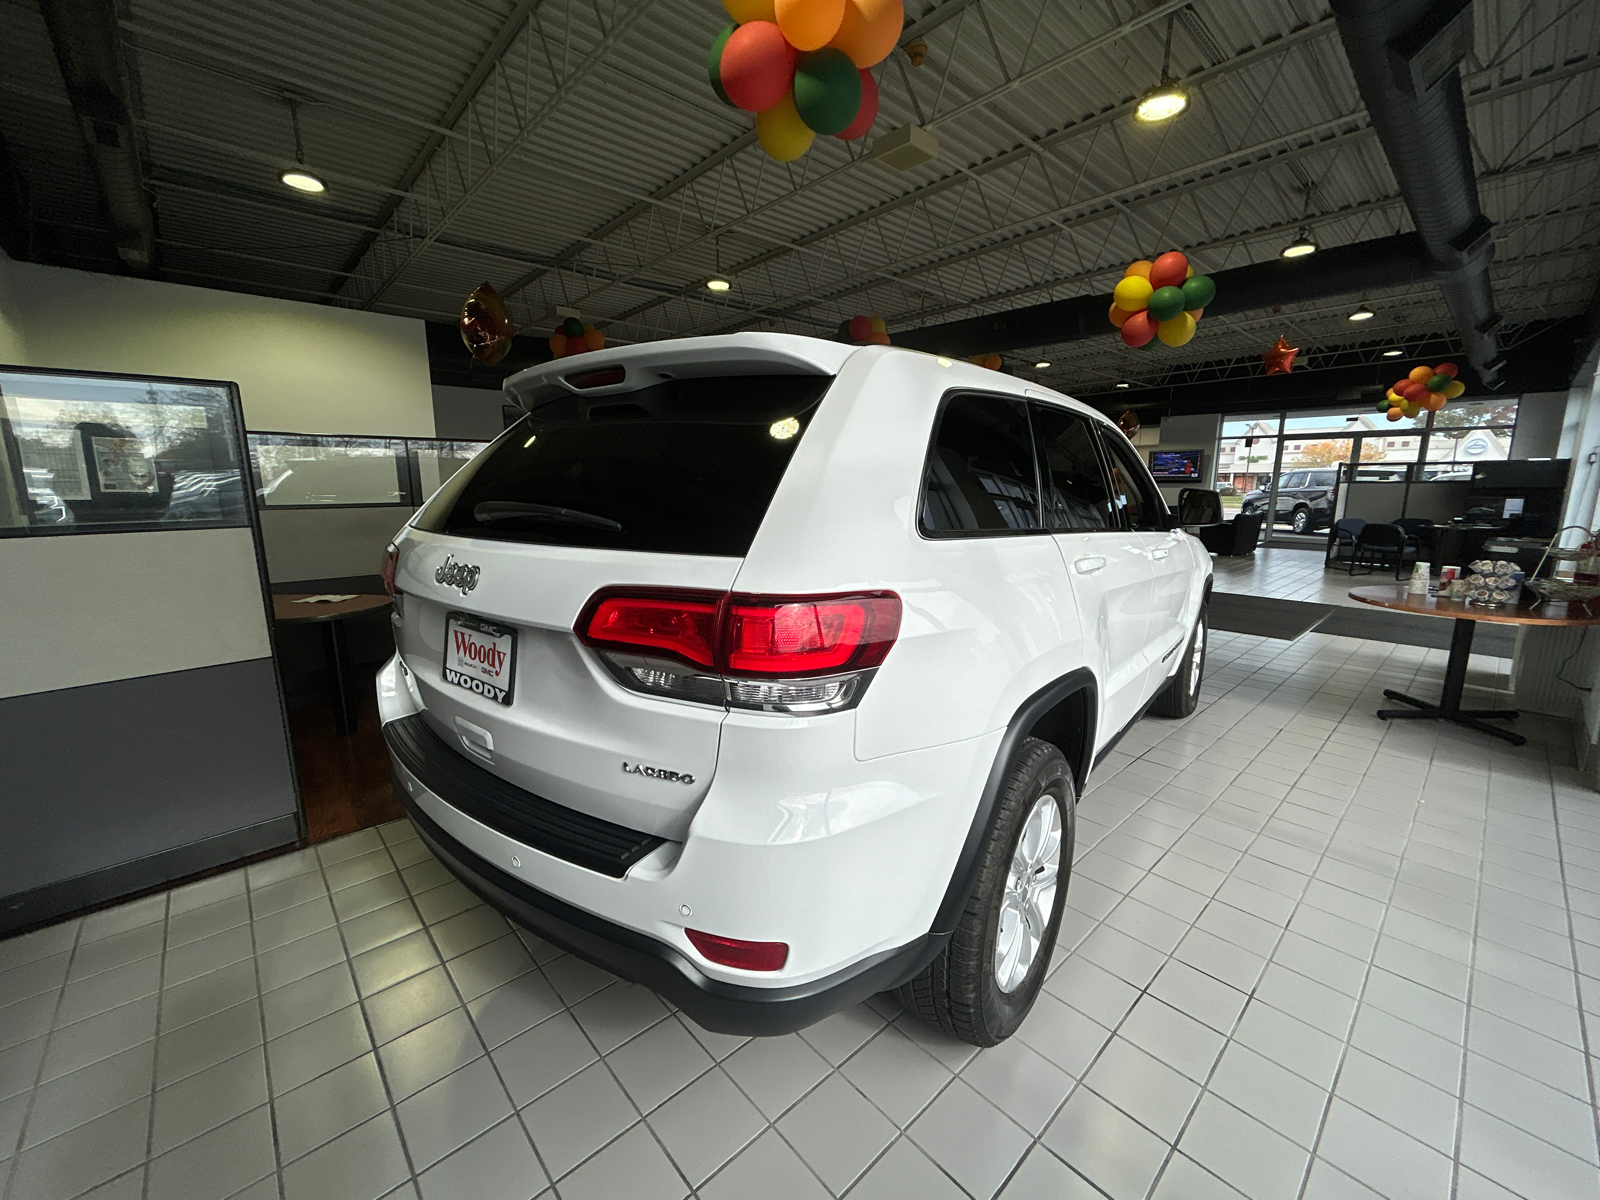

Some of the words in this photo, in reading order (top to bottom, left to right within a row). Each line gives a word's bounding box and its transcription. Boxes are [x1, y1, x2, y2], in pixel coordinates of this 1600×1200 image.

[434, 554, 480, 595] Jeep
[453, 630, 506, 676] Woody
[446, 669, 506, 703] WOODY
[622, 761, 696, 784] LAREDO
